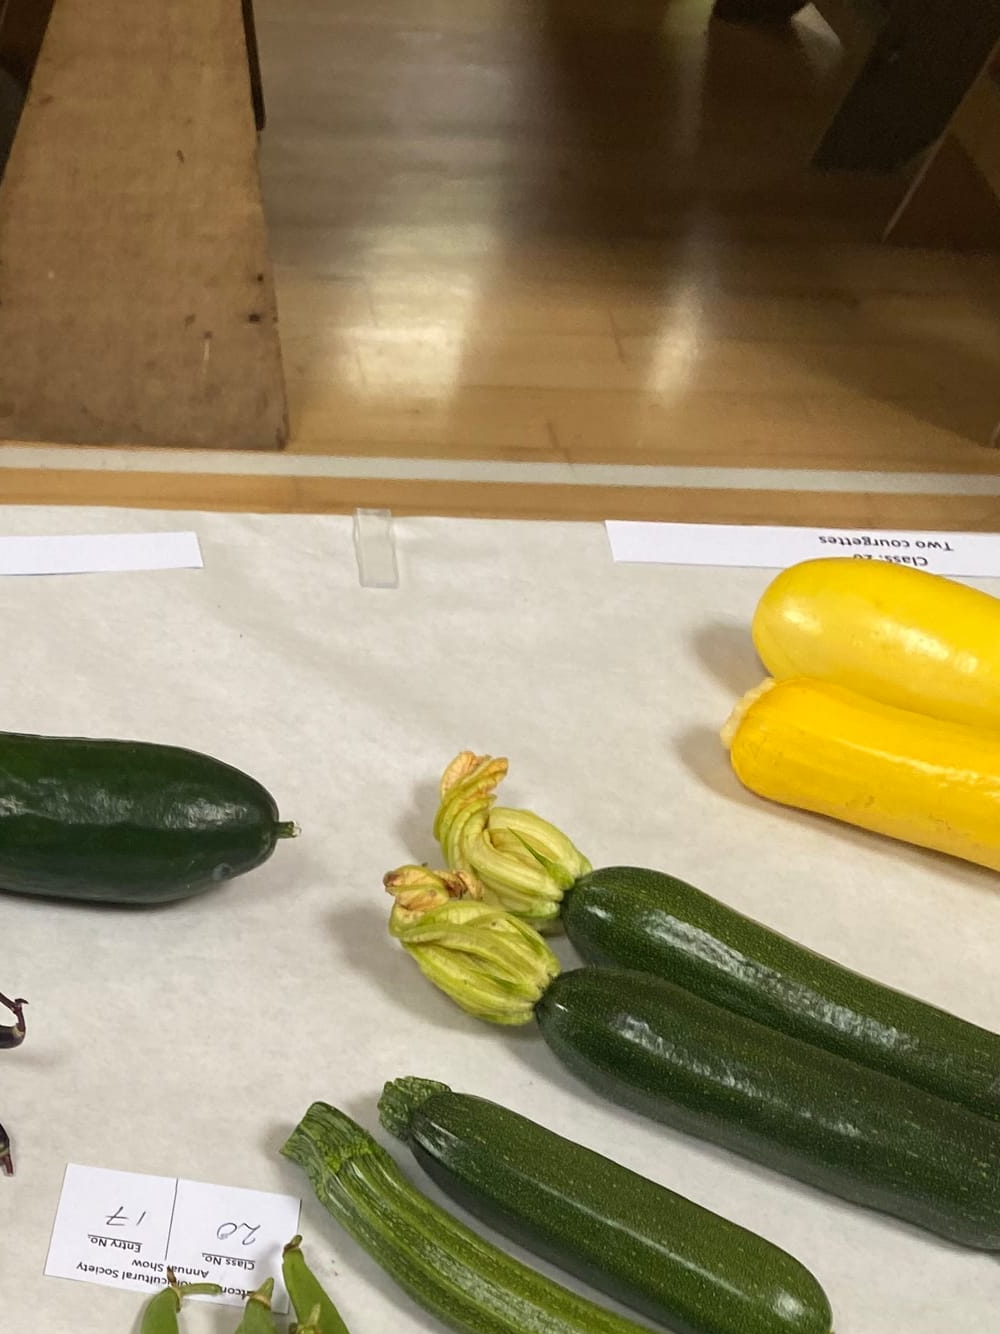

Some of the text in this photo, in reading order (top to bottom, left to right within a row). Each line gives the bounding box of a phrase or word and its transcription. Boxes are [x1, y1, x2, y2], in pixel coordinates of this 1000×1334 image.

[818, 536, 953, 551] Two courgettes
[105, 1206, 146, 1226] 17
[216, 1222, 261, 1246] 20
[87, 1235, 142, 1253] Entry No.
[76, 1262, 119, 1278] Society
[131, 1259, 209, 1278] Annua Show
[201, 1254, 255, 1270] Class No.
